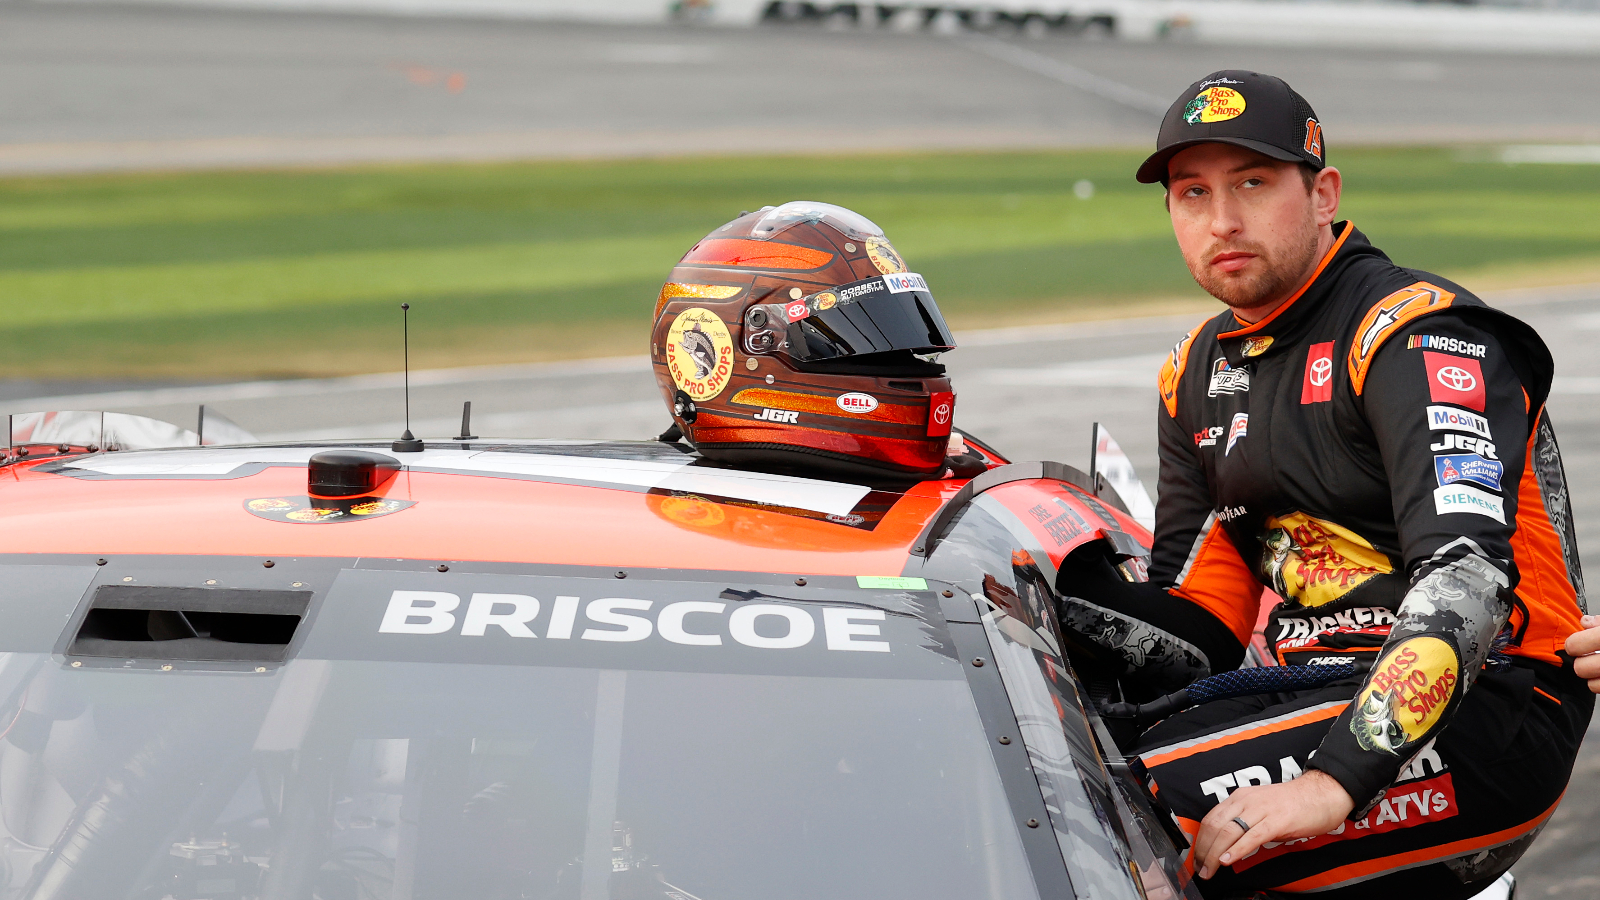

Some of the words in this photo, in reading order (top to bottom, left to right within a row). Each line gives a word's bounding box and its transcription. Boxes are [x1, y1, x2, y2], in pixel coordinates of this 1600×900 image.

[1209, 88, 1235, 98] Bass
[1210, 97, 1228, 106] Pro
[1209, 106, 1241, 116] Shops
[889, 276, 919, 291] Mobil
[1429, 335, 1486, 358] NASCAR
[668, 343, 683, 381] BASS
[683, 378, 705, 394] PRO
[707, 346, 731, 391] SHOPS
[843, 397, 871, 407] BELL
[754, 408, 800, 424] JGR
[1434, 411, 1474, 428] Mobil
[1475, 419, 1485, 433] 1
[1430, 433, 1499, 459] JGR
[1461, 460, 1498, 471] SHERWIN
[1461, 468, 1499, 480] WILLIAMS
[1443, 493, 1500, 514] SIEMENS
[378, 590, 892, 652] BRISCOE
[1276, 607, 1397, 641] TRACKER
[1372, 646, 1419, 694] Bass
[1391, 669, 1428, 708] Pro
[1408, 667, 1456, 726] Shops
[1376, 788, 1448, 826] ATVs
